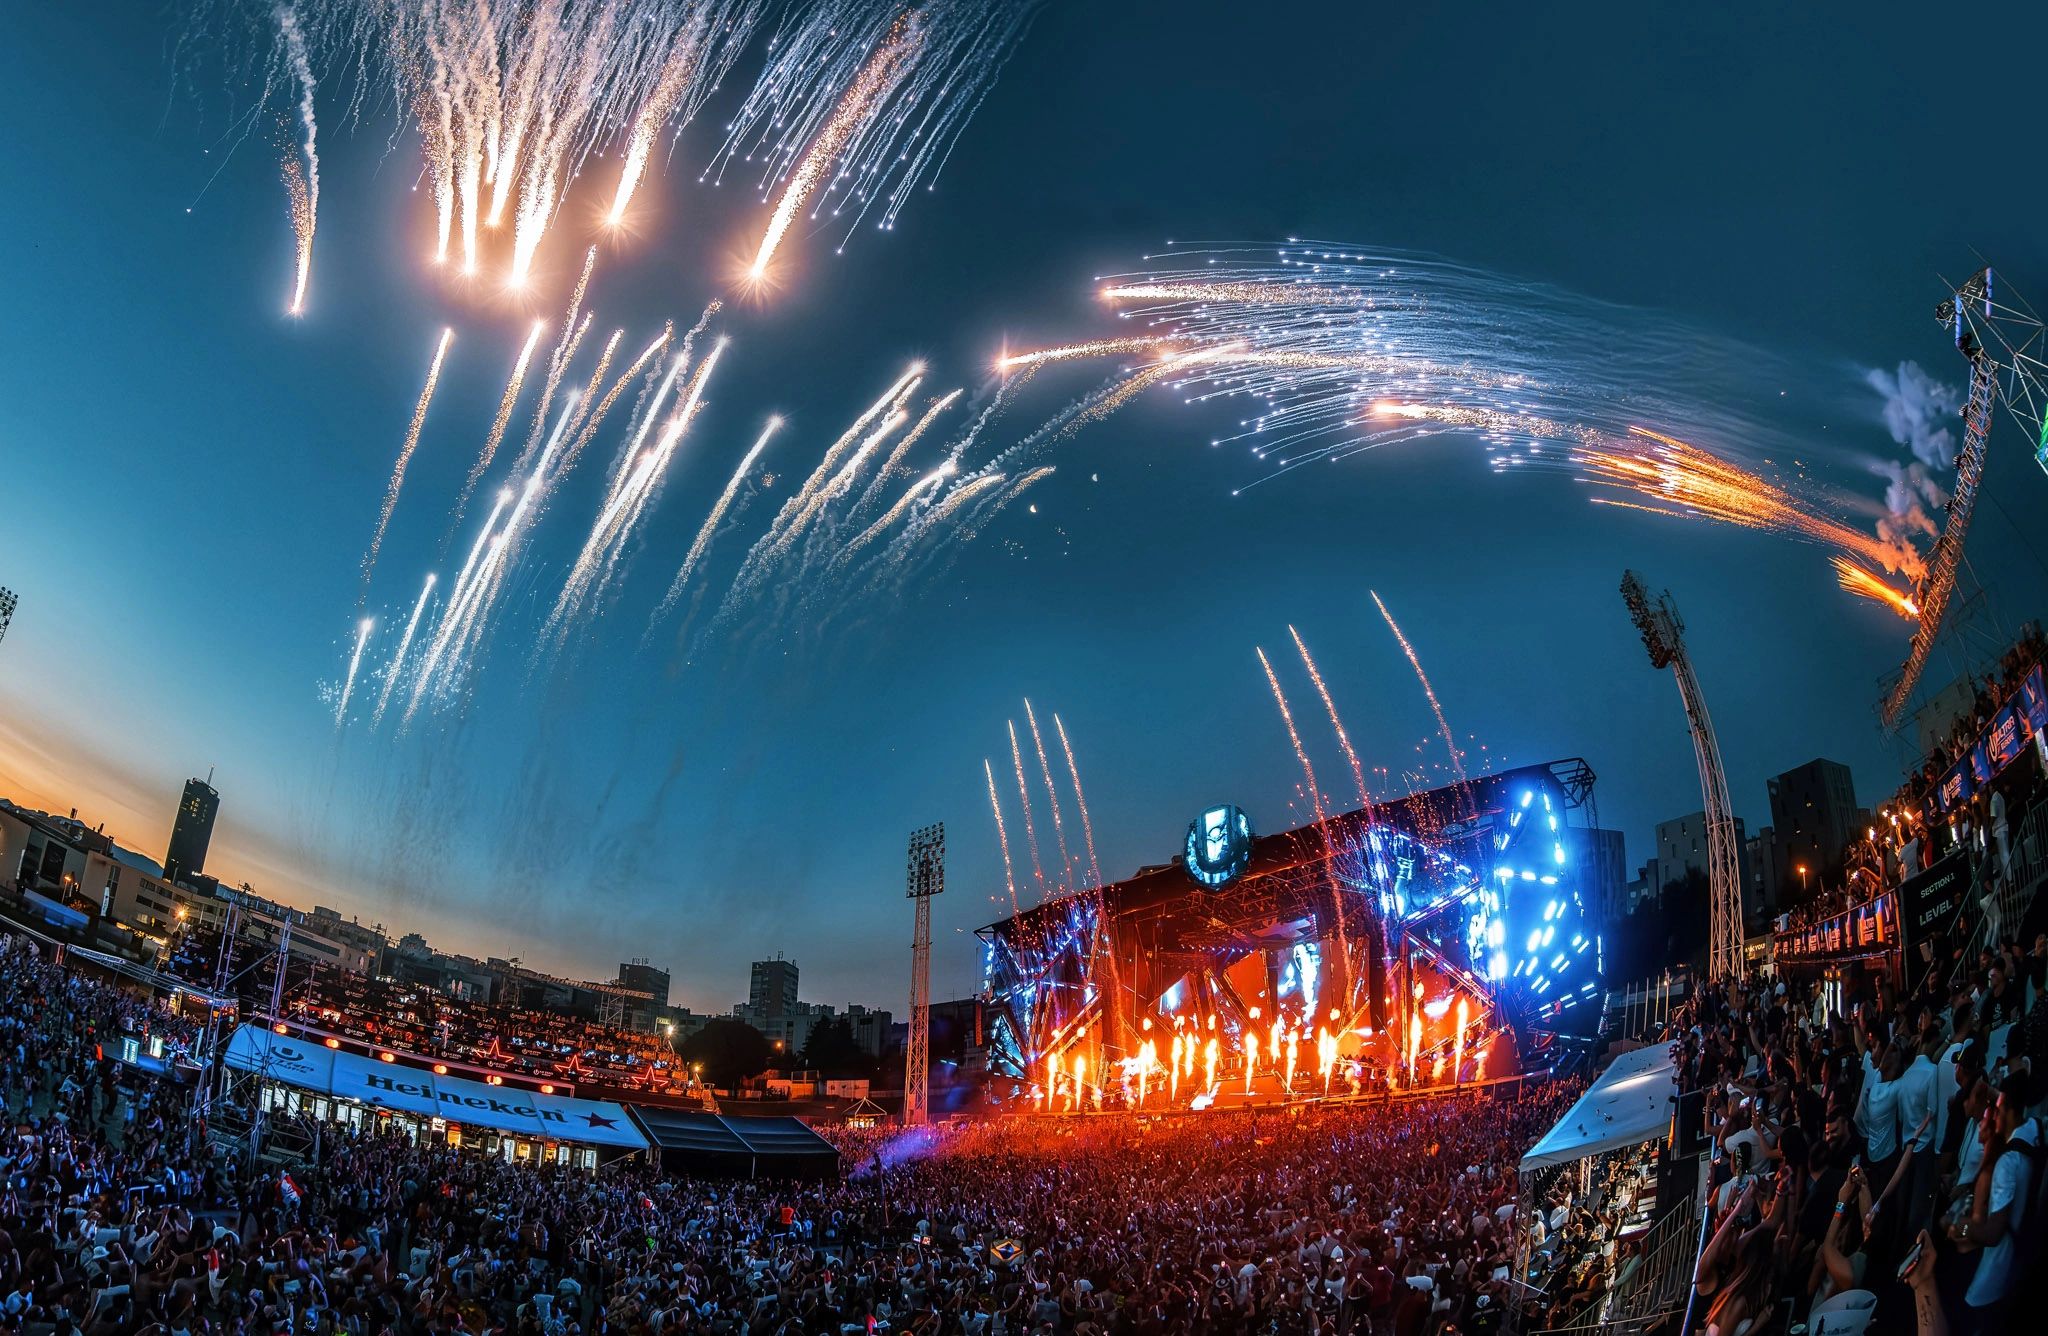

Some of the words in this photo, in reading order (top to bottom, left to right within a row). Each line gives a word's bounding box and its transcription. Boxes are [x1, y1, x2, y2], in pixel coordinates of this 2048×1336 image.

[1920, 875, 1950, 899] SECTION
[1919, 899, 1953, 926] LEVEL
[365, 1073, 569, 1124] Heineken
